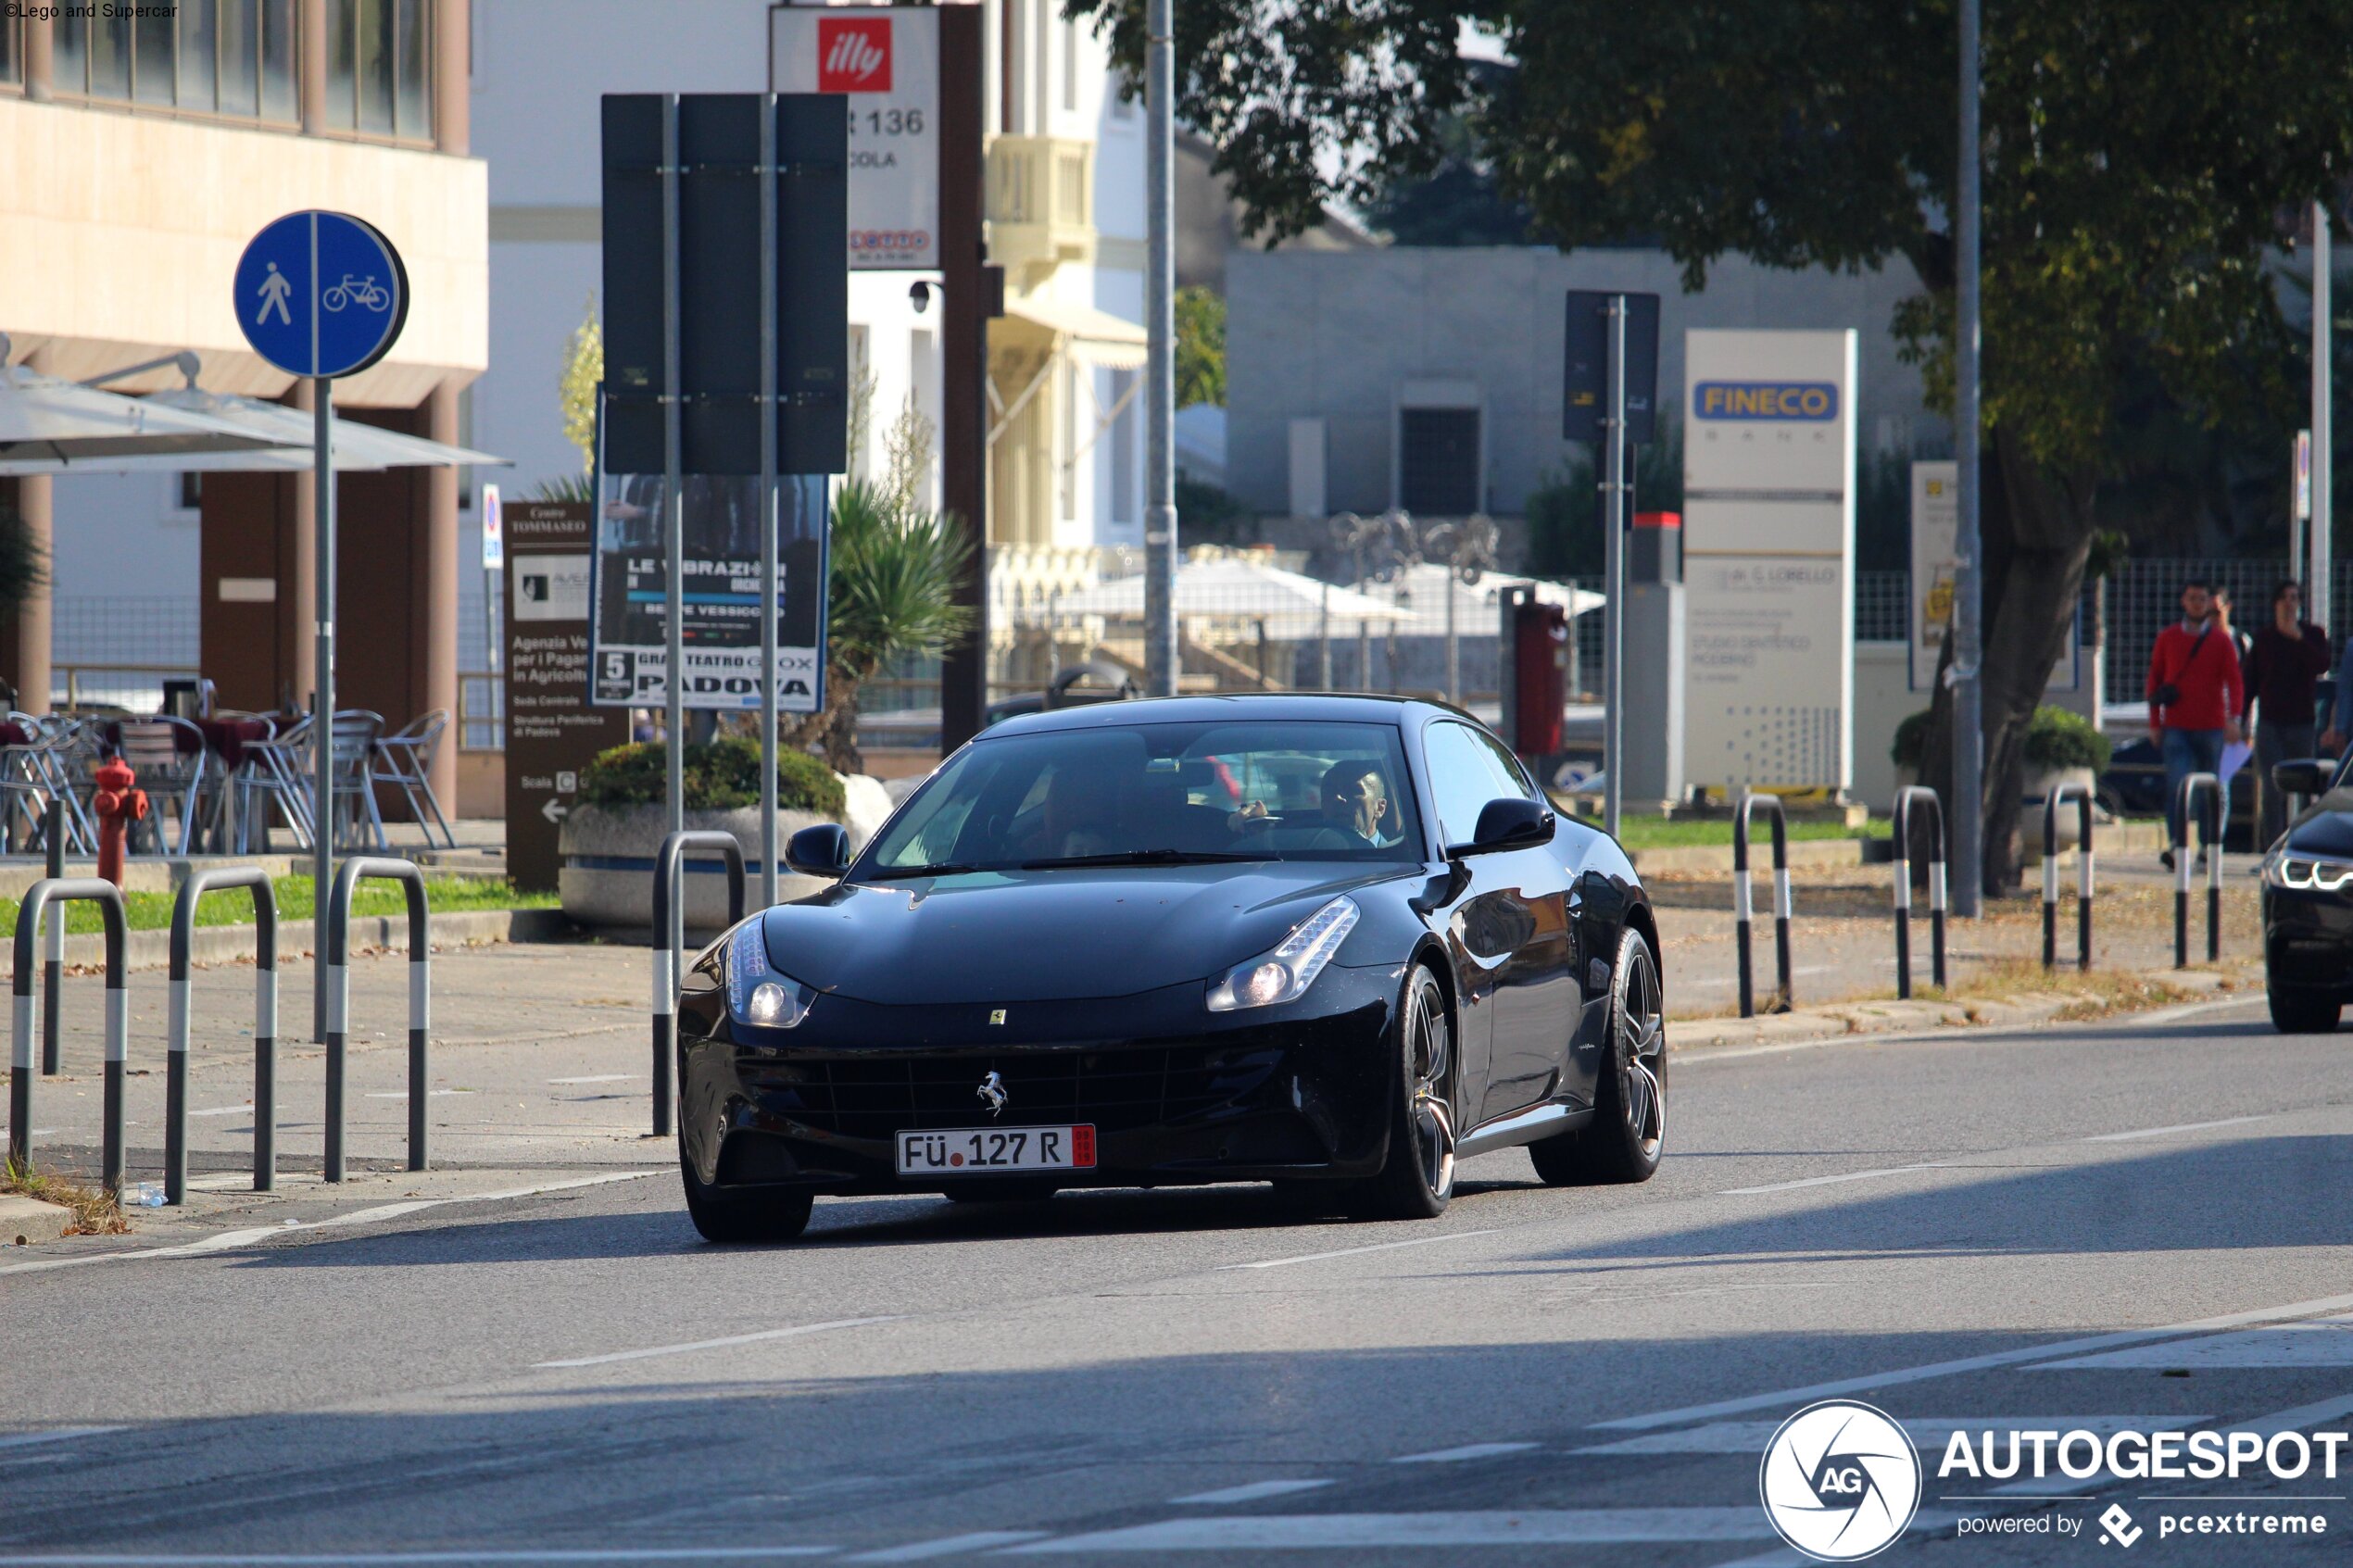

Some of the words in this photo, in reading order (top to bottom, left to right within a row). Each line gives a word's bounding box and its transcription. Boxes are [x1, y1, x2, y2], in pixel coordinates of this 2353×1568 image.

[824, 31, 884, 83] illy
[865, 108, 925, 136] 136
[1704, 387, 1830, 416] FINECO
[627, 558, 655, 573] LE
[645, 604, 695, 616] BEE
[698, 605, 786, 619] VESSICCO
[513, 635, 567, 651] Agenzia
[513, 654, 535, 667] per
[606, 652, 626, 680] 5
[638, 654, 669, 667] GRA
[686, 654, 744, 668] TEATRO
[747, 657, 813, 669] GOX
[513, 671, 527, 683] in
[522, 775, 553, 789] Scala
[904, 1135, 947, 1168] FÜ
[968, 1132, 1027, 1166] 127
[1040, 1132, 1061, 1163] R
